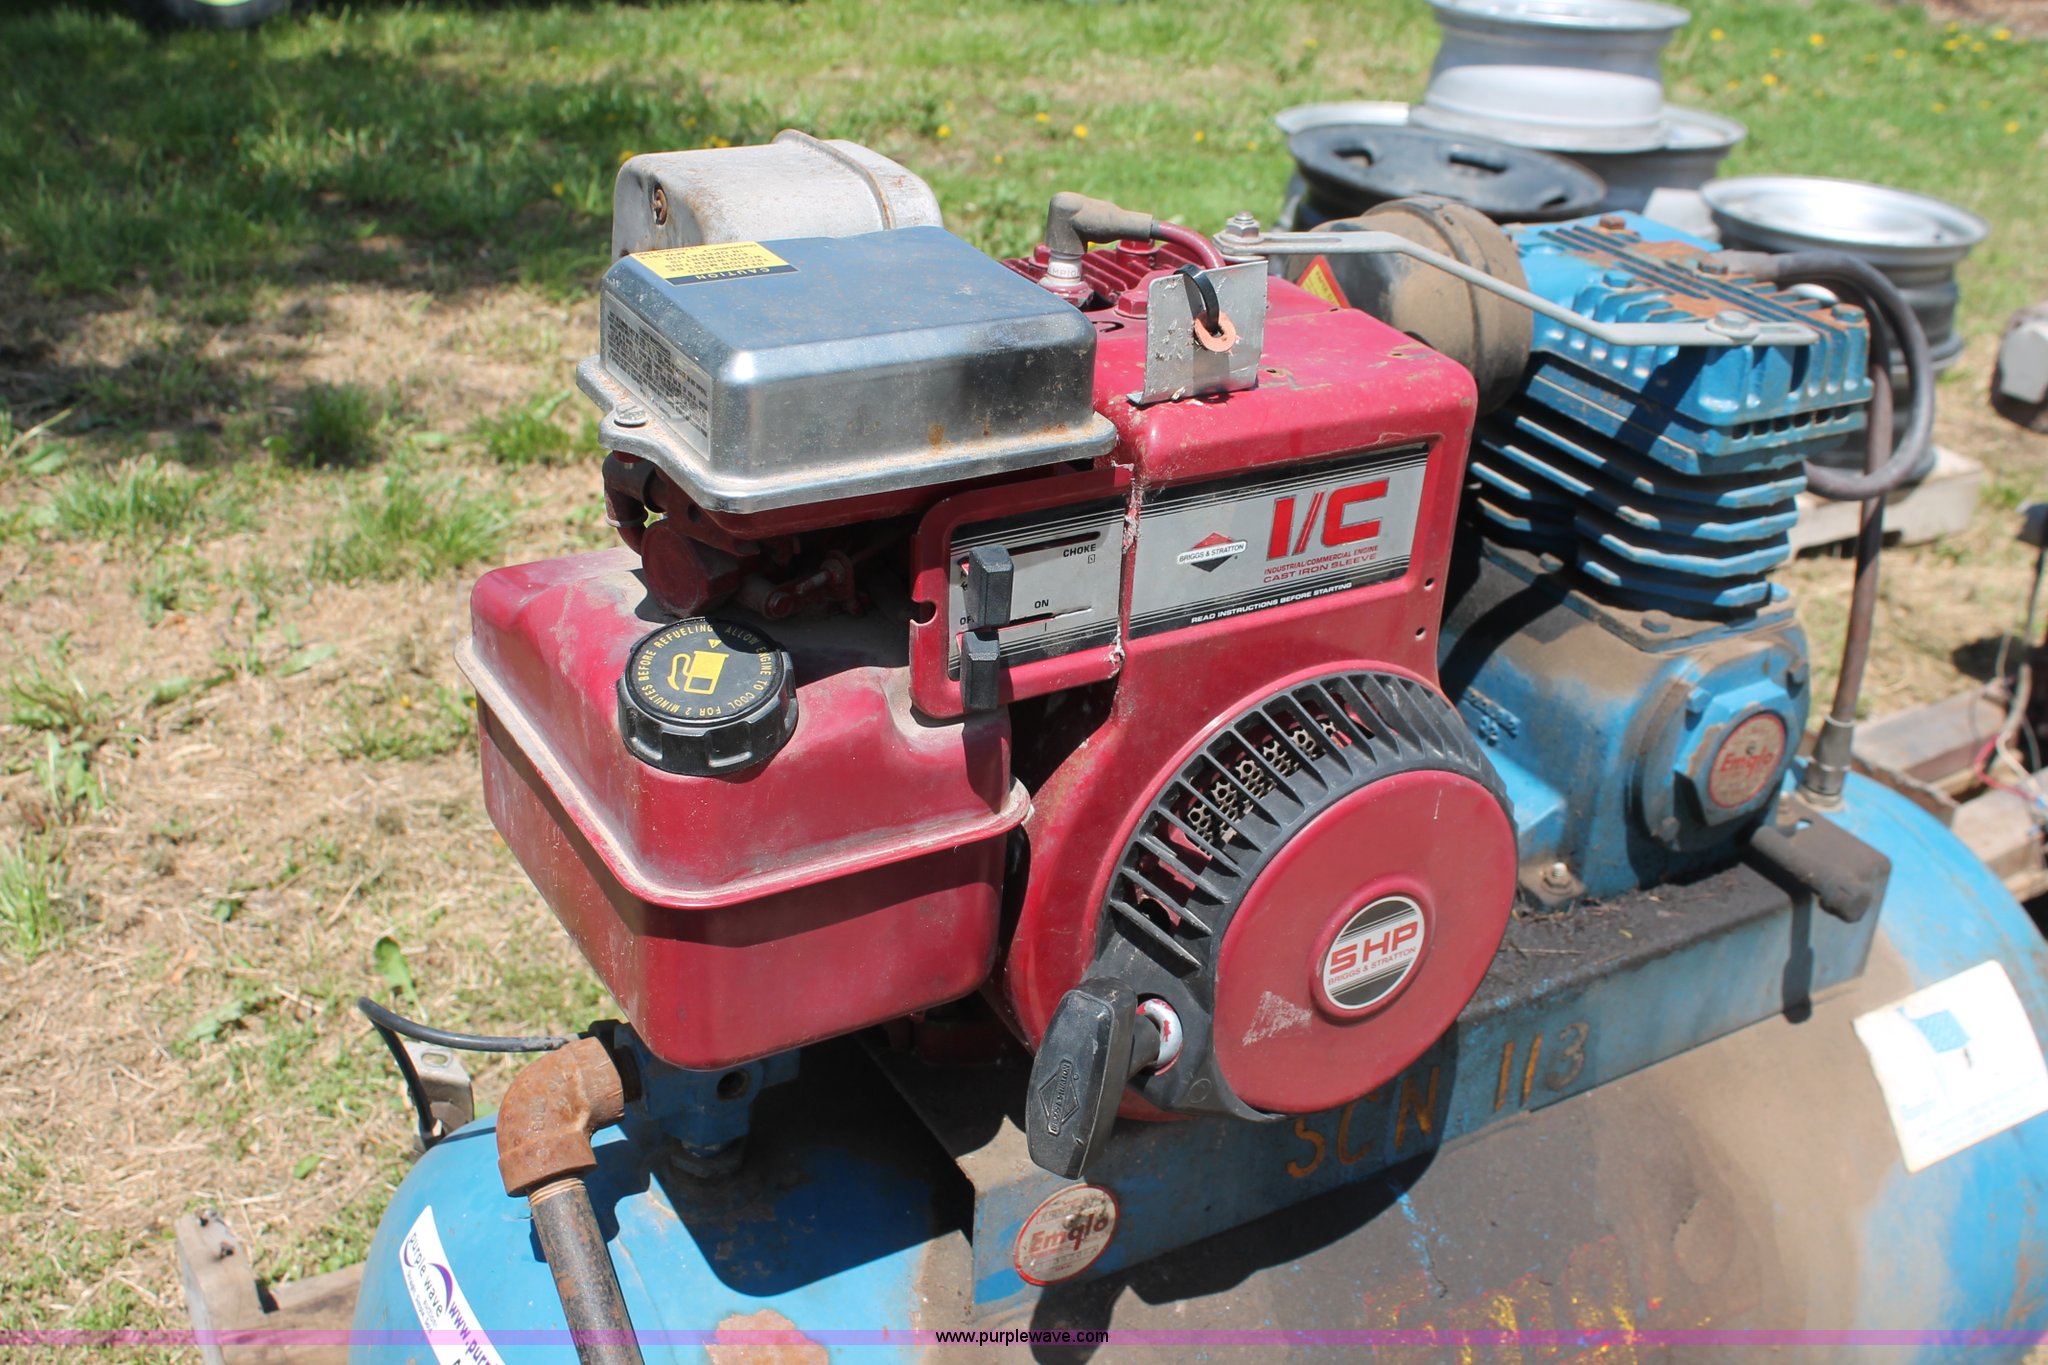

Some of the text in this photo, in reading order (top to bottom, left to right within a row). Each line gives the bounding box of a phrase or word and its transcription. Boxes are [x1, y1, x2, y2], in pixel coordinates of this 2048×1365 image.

[695, 267, 770, 280] CAUTION
[1063, 544, 1096, 558] CHOKE
[1179, 551, 1204, 563] BRIGGS
[1210, 543, 1245, 557] STRATTON
[1264, 545, 1379, 575] INDUSTRIAL/COMMERCIAL ENGINE
[1263, 553, 1377, 583] CAST IRON SLEEVE
[1034, 599, 1049, 609] ON
[1191, 582, 1352, 623] READ INSTRUCTIONS BEFORE STARTING
[960, 617, 975, 626] OF
[638, 624, 773, 716] ALLOW ENGINE TO COOL FOR 2 MINUTES BEFORE REFUELING
[1329, 921, 1418, 975] 5 HP
[1327, 947, 1416, 985] BRIGGS & STRATTON
[1494, 1021, 1590, 1112] 113
[408, 1232, 426, 1277] purple
[424, 1275, 443, 1317] wave
